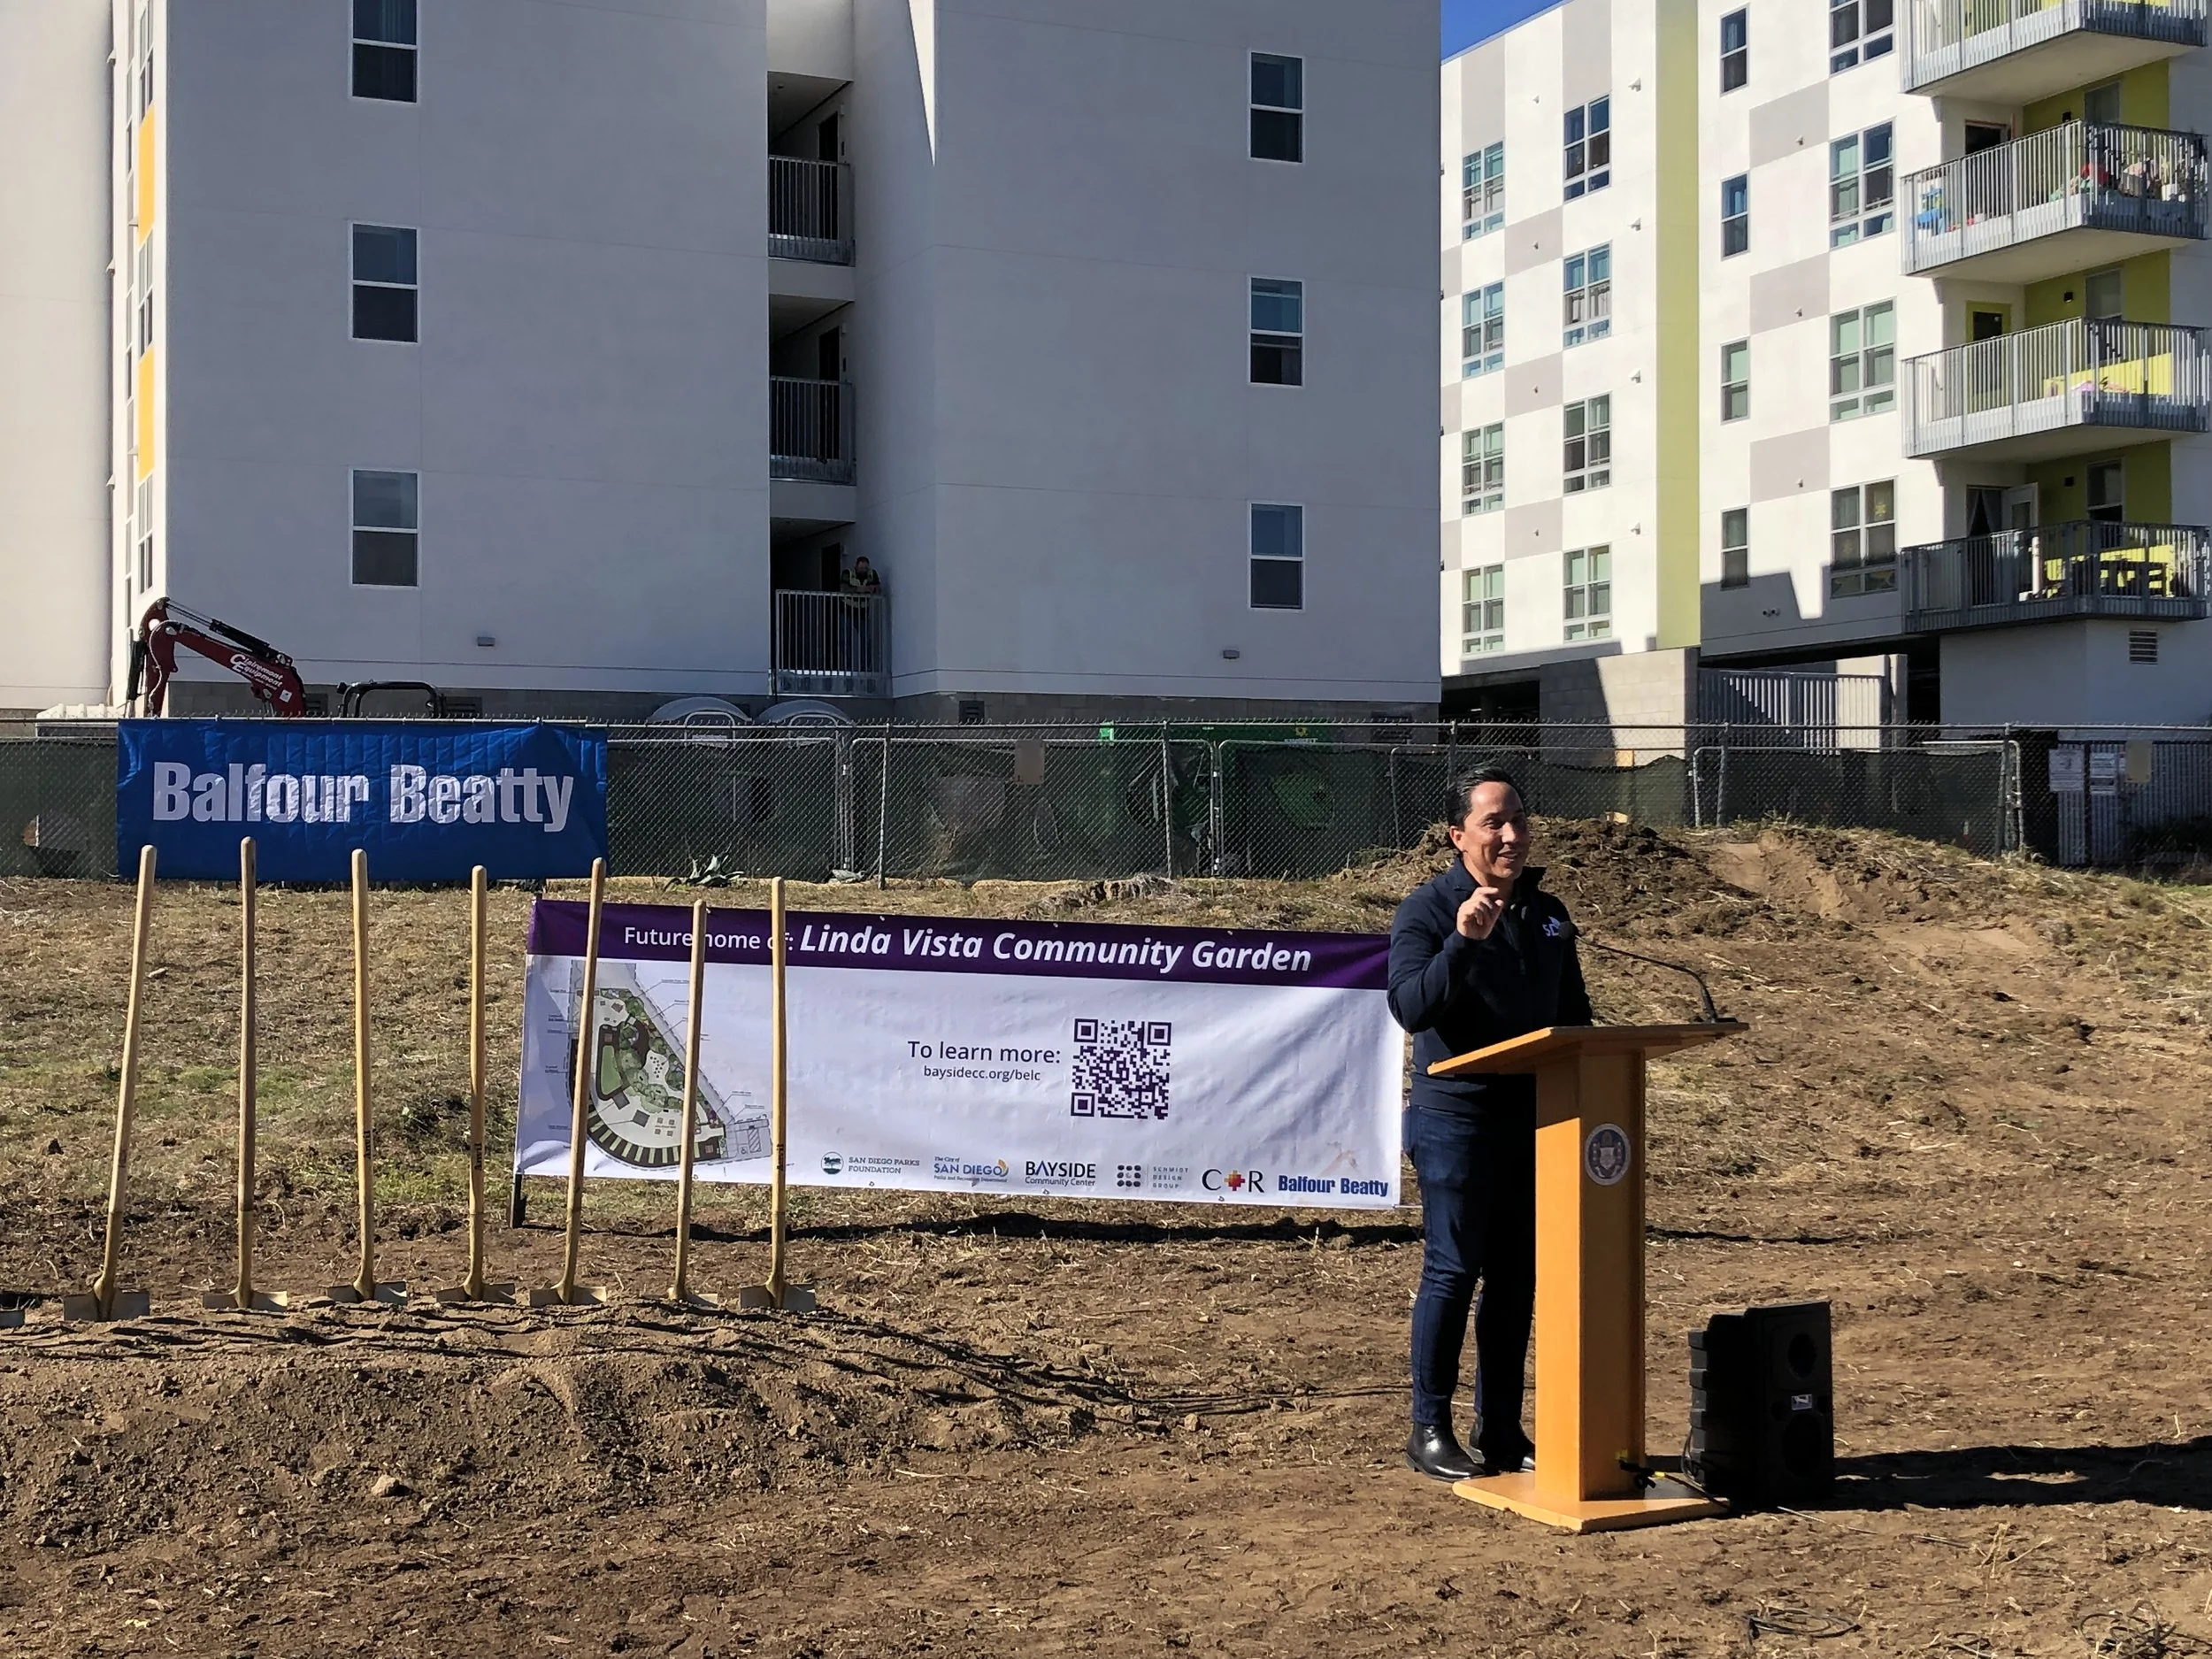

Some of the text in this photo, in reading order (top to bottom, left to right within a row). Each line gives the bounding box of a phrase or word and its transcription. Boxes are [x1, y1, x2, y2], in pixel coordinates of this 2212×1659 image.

[153, 762, 574, 833] Balfour Beatty
[625, 926, 693, 947] Future
[800, 925, 891, 955] Linda
[903, 928, 983, 958] Vista
[993, 932, 1185, 972] Community
[1191, 941, 1312, 972] Garden
[908, 1041, 1061, 1064] To learn more:
[924, 1065, 1041, 1082] baysidecc.org/belc
[849, 1165, 902, 1174] FOUNDATION
[933, 1163, 1002, 1176] SAN DIEGO
[1025, 1160, 1096, 1179] BAYSIDE
[1025, 1176, 1095, 1187] Community Center
[1278, 1175, 1389, 1197] Balfour Beatty
